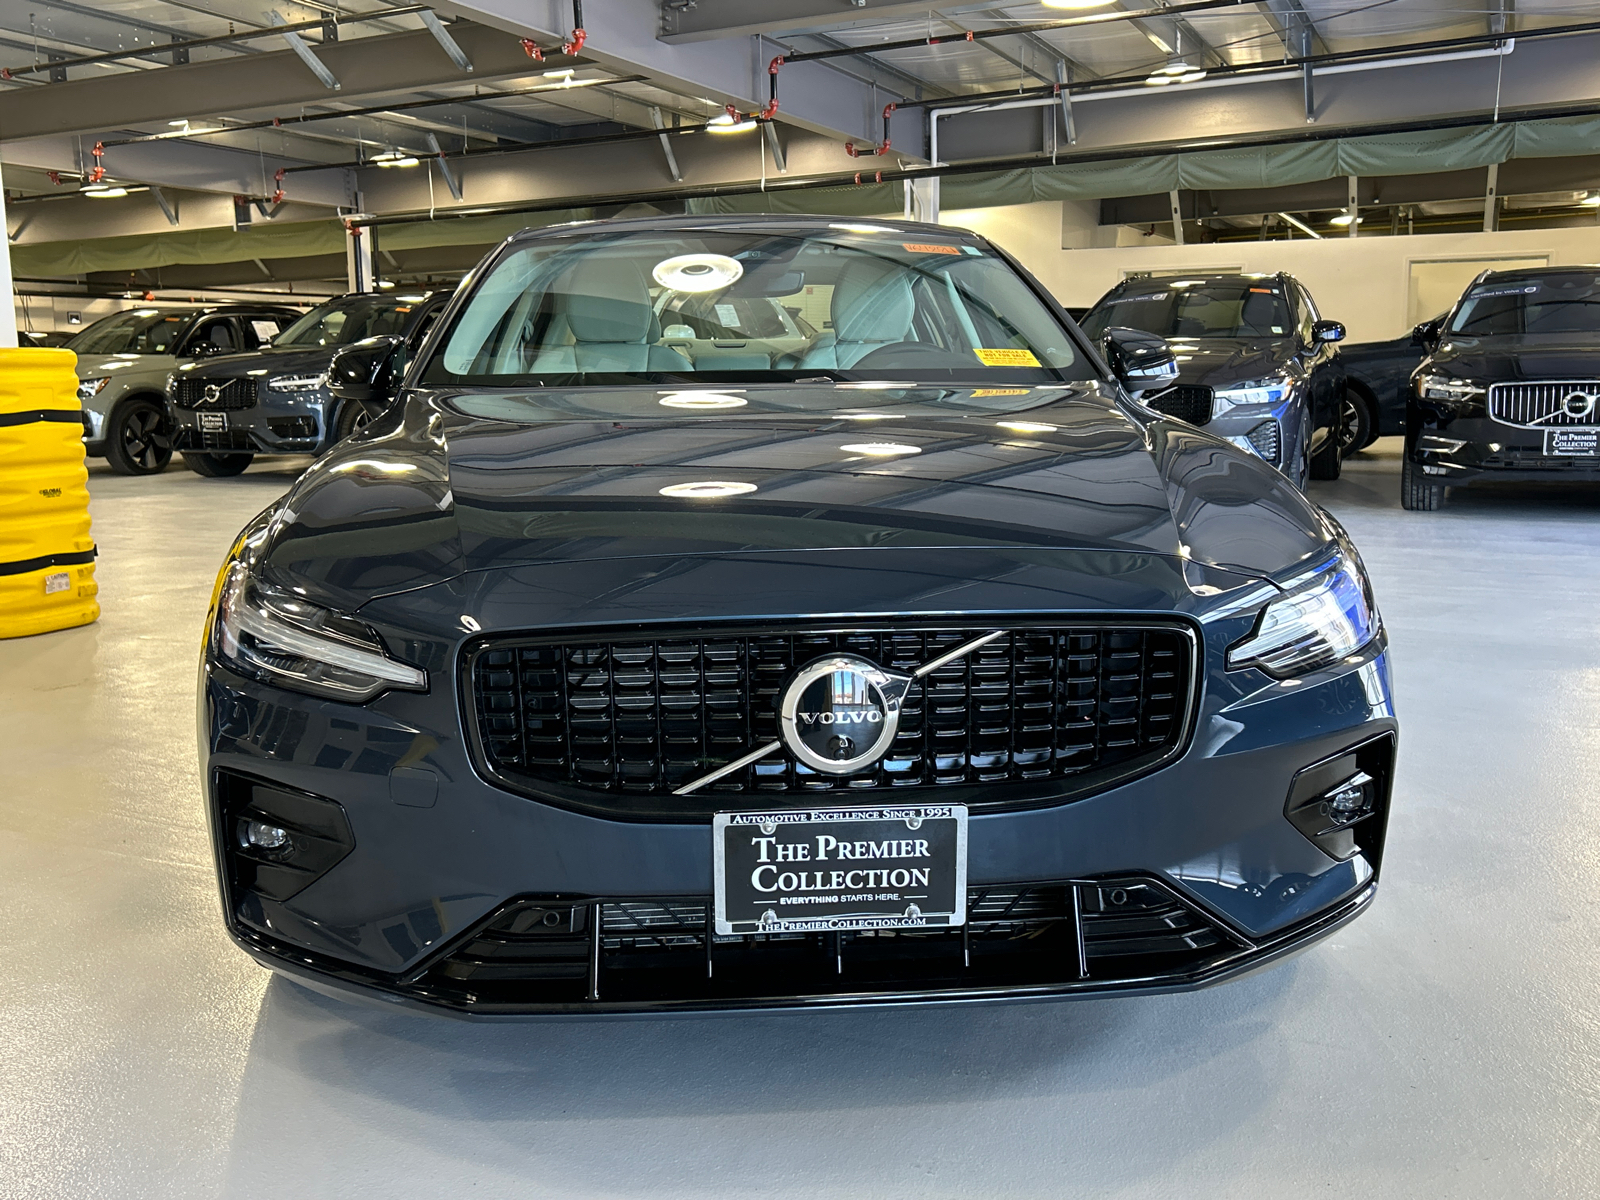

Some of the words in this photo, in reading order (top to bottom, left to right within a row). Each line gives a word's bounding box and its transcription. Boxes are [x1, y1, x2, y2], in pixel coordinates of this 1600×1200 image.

[1552, 440, 1597, 448] COLLECTION
[1553, 433, 1568, 441] THE
[1569, 433, 1598, 441] PREMIER
[799, 711, 882, 725] VOLVO
[810, 811, 880, 821] EXCELLENCE
[882, 809, 916, 819] SINCE
[919, 807, 951, 818] 1995
[751, 836, 811, 863] THE
[815, 835, 931, 861] PREMIER
[751, 864, 931, 893] COLLECTION
[780, 895, 839, 905] EVERYTHING
[840, 894, 874, 903] STARTS
[875, 893, 901, 901] HERE.
